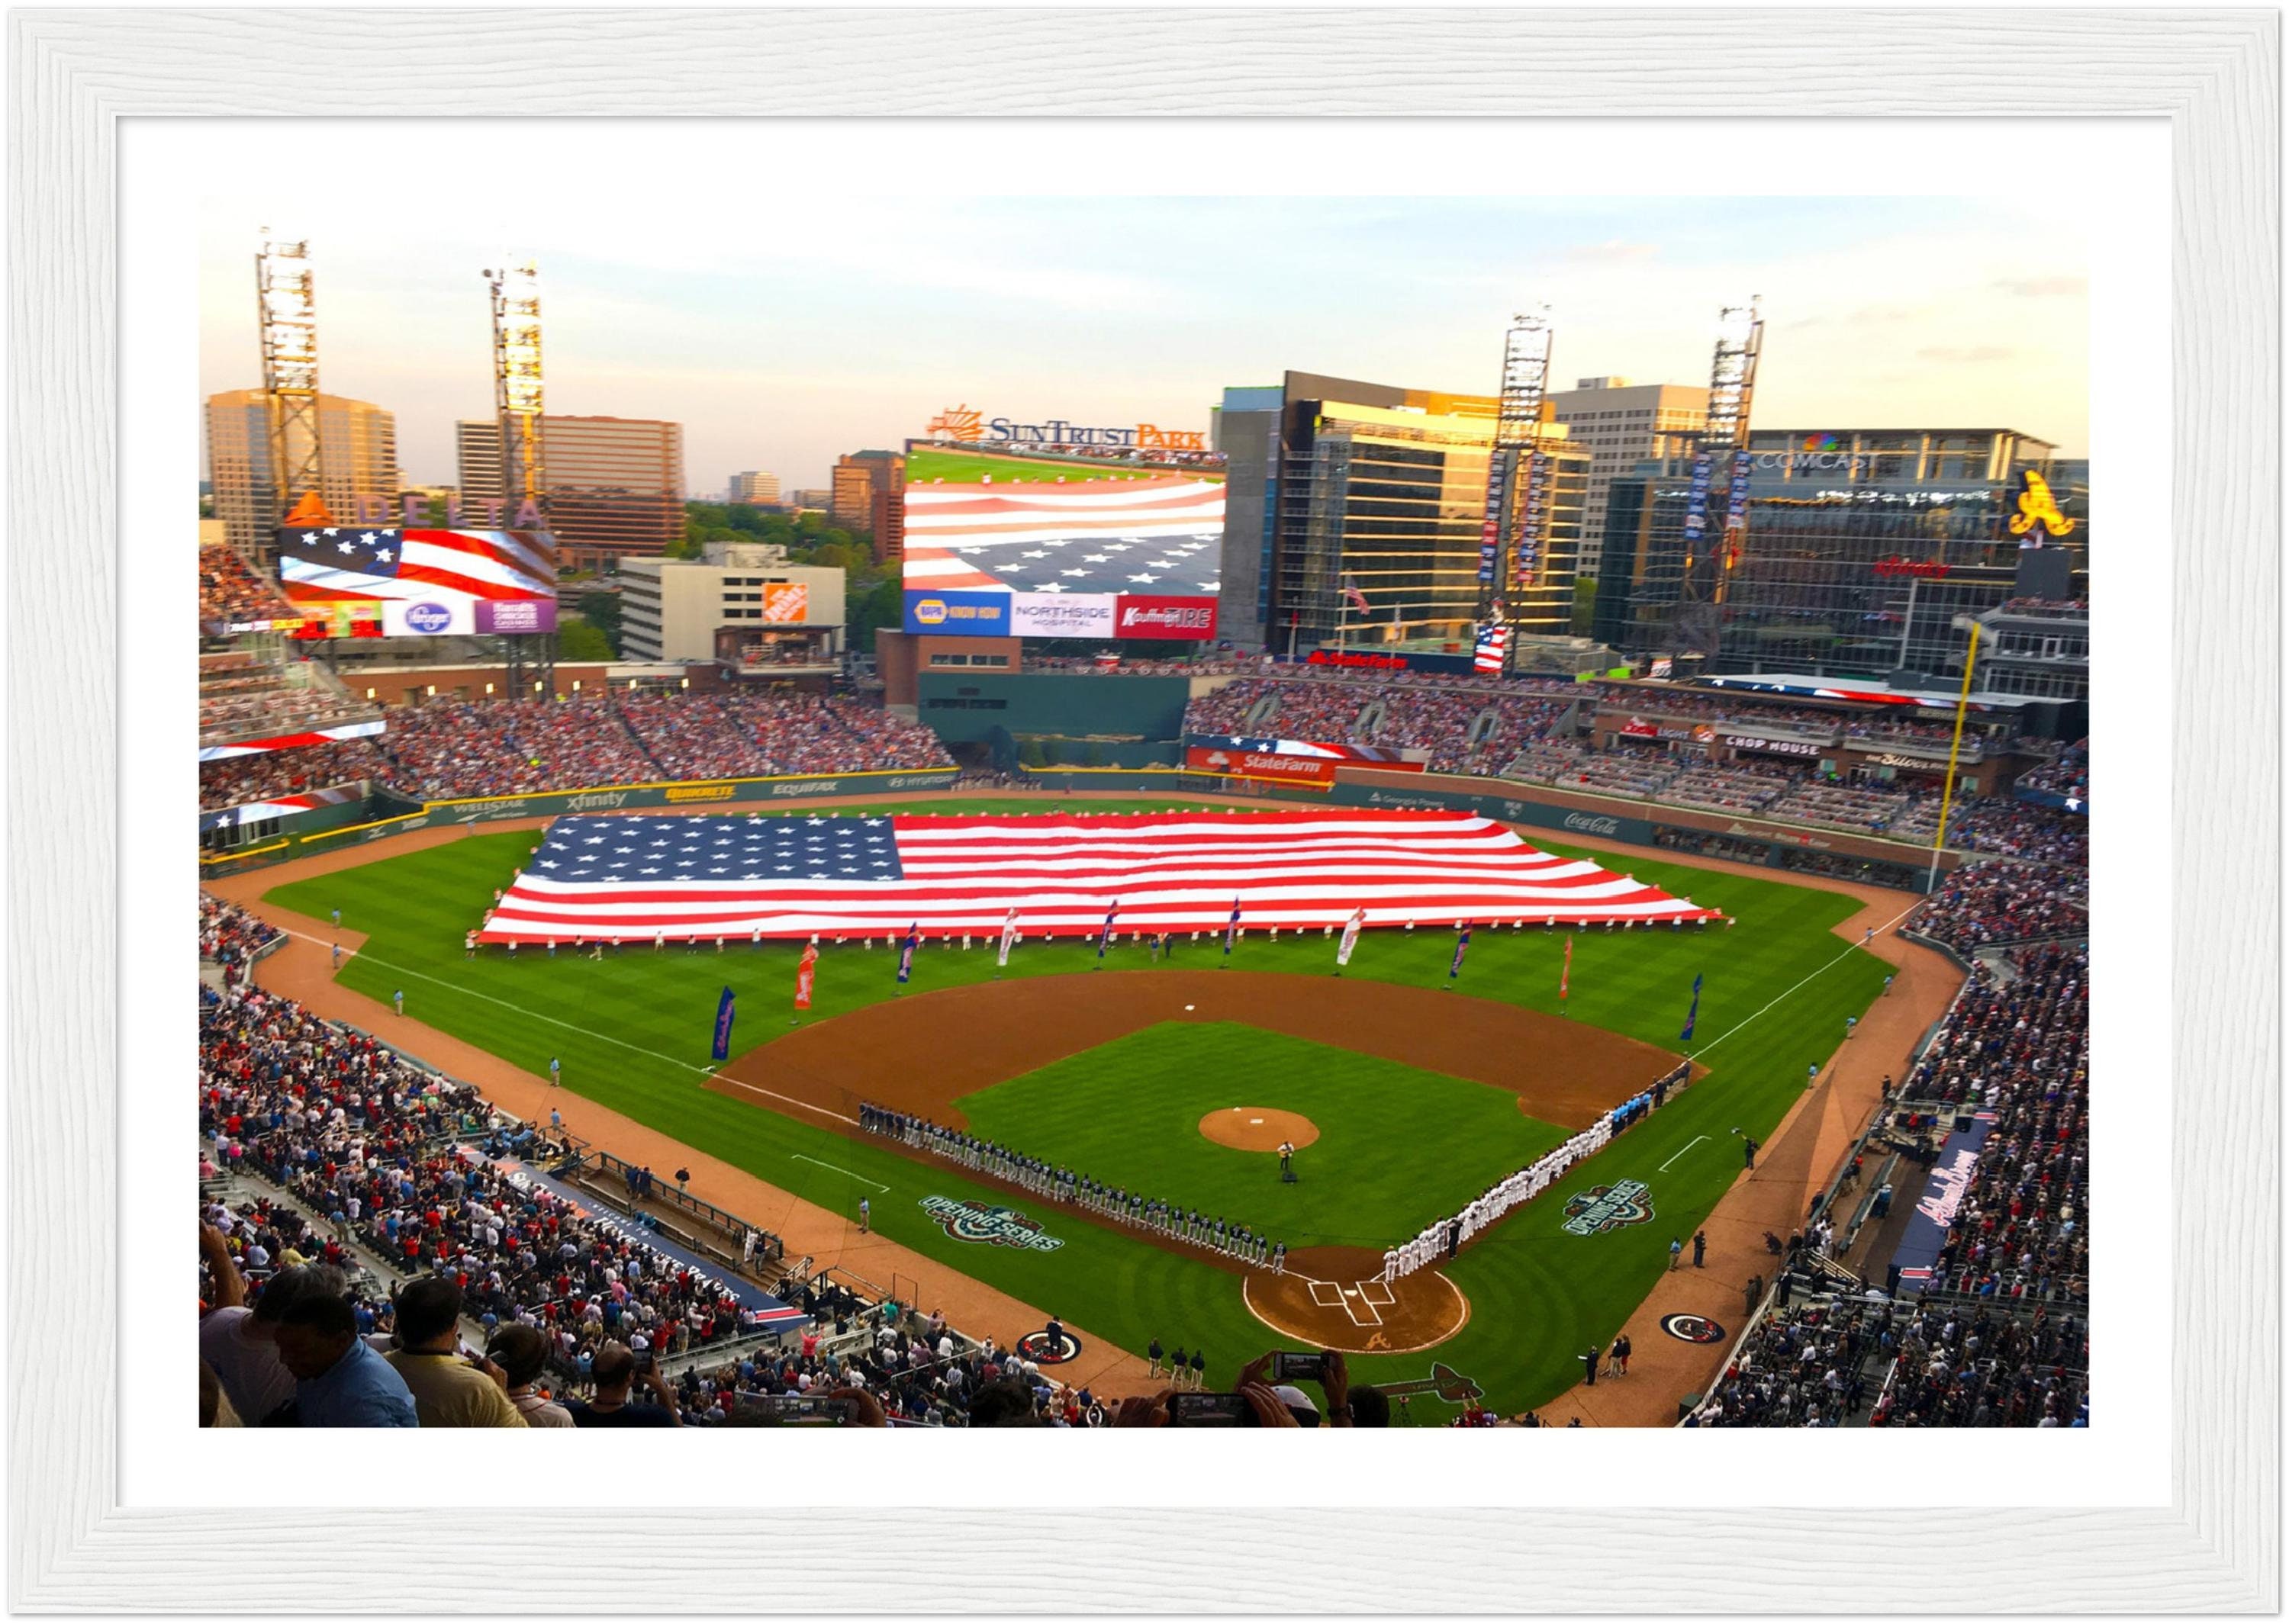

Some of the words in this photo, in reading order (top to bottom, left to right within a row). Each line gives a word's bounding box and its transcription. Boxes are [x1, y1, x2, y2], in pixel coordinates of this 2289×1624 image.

[1756, 452, 1879, 469] COMCAST
[357, 494, 544, 528] DELTA
[1016, 606, 1111, 620] NORTHSIDE
[1032, 619, 1094, 628] HOSPITAL
[1164, 607, 1213, 629] TIRE
[1726, 735, 1766, 748] CHOP
[1769, 741, 1821, 756] HOUSE
[772, 780, 839, 796] EQUIFAX
[567, 791, 628, 812] xfinity
[1565, 1201, 1619, 1235] OPENING
[1603, 1180, 1645, 1204] SERIES
[922, 1195, 1001, 1227] OPENING
[995, 1221, 1061, 1250] SERIES
